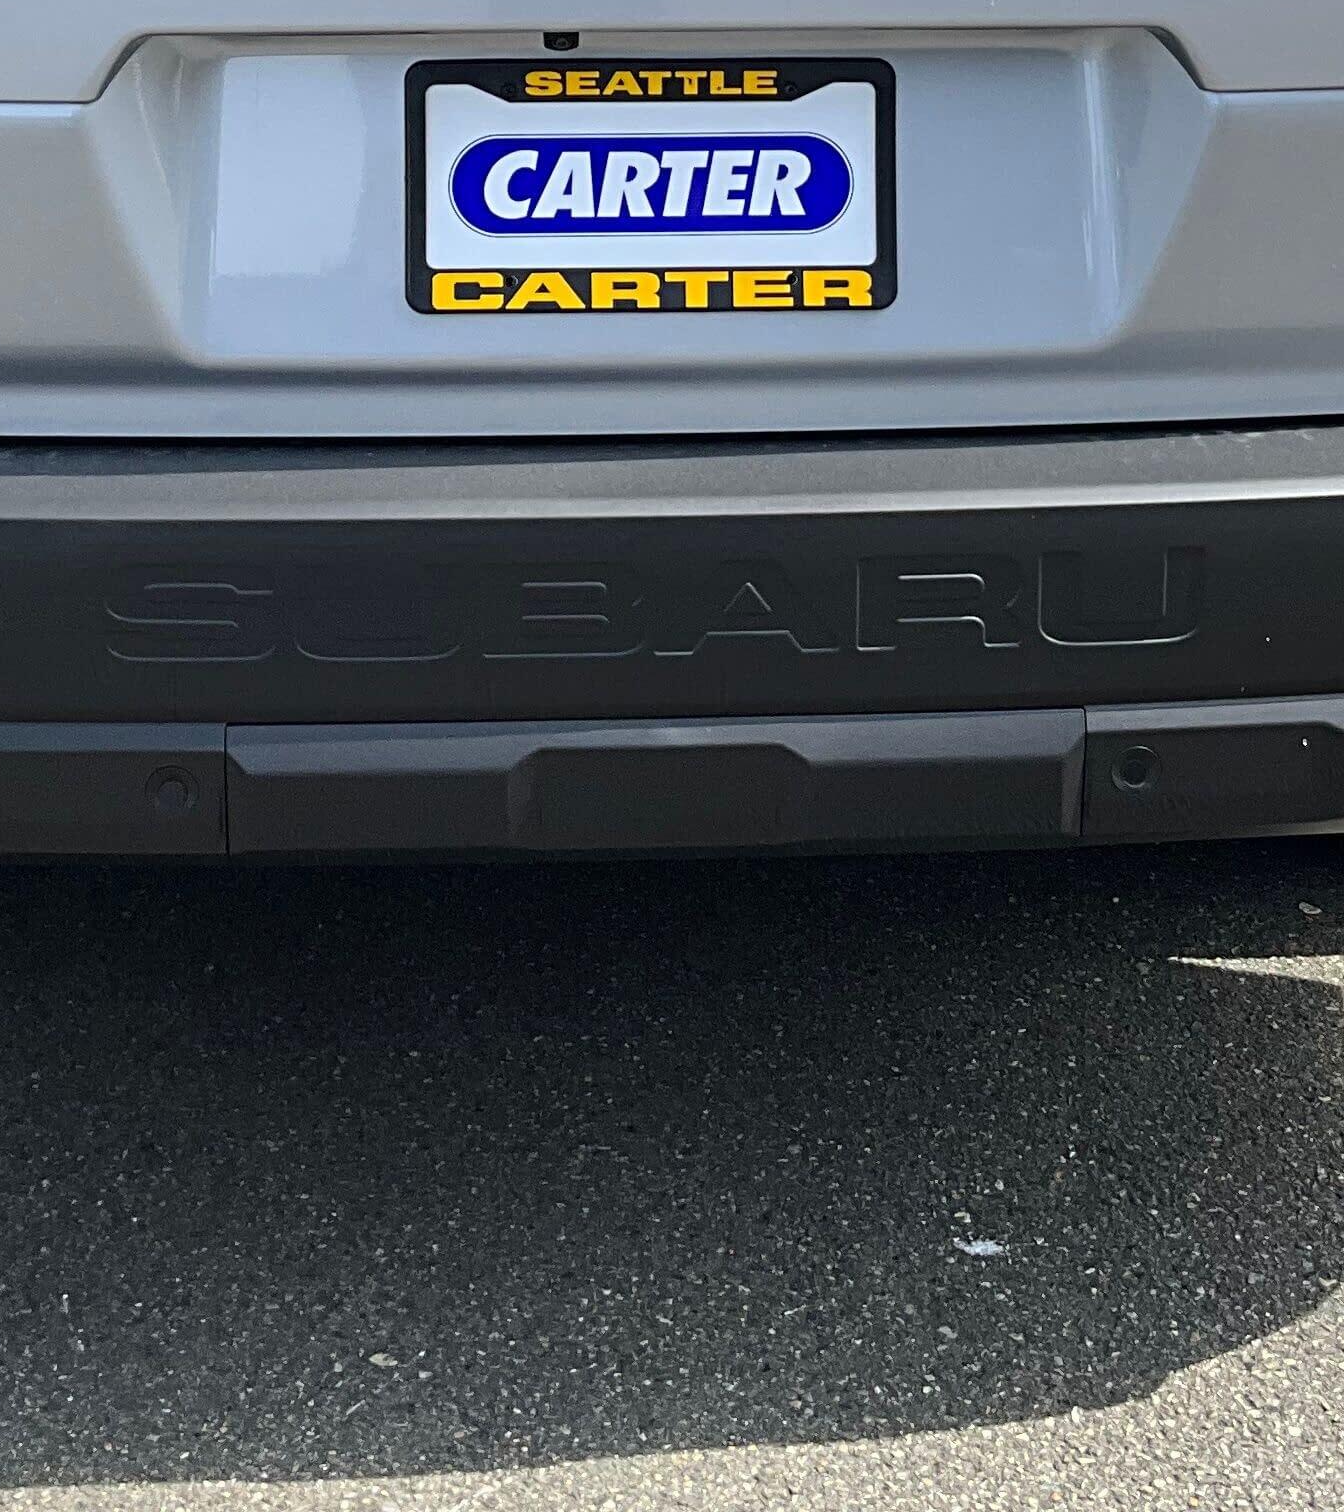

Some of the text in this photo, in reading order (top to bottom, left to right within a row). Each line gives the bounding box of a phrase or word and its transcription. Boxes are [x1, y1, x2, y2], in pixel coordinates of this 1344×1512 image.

[524, 70, 779, 96] SEATTLE
[483, 148, 812, 220] CARTER
[431, 271, 873, 311] CARTER
[106, 544, 1208, 662] SUBARU
